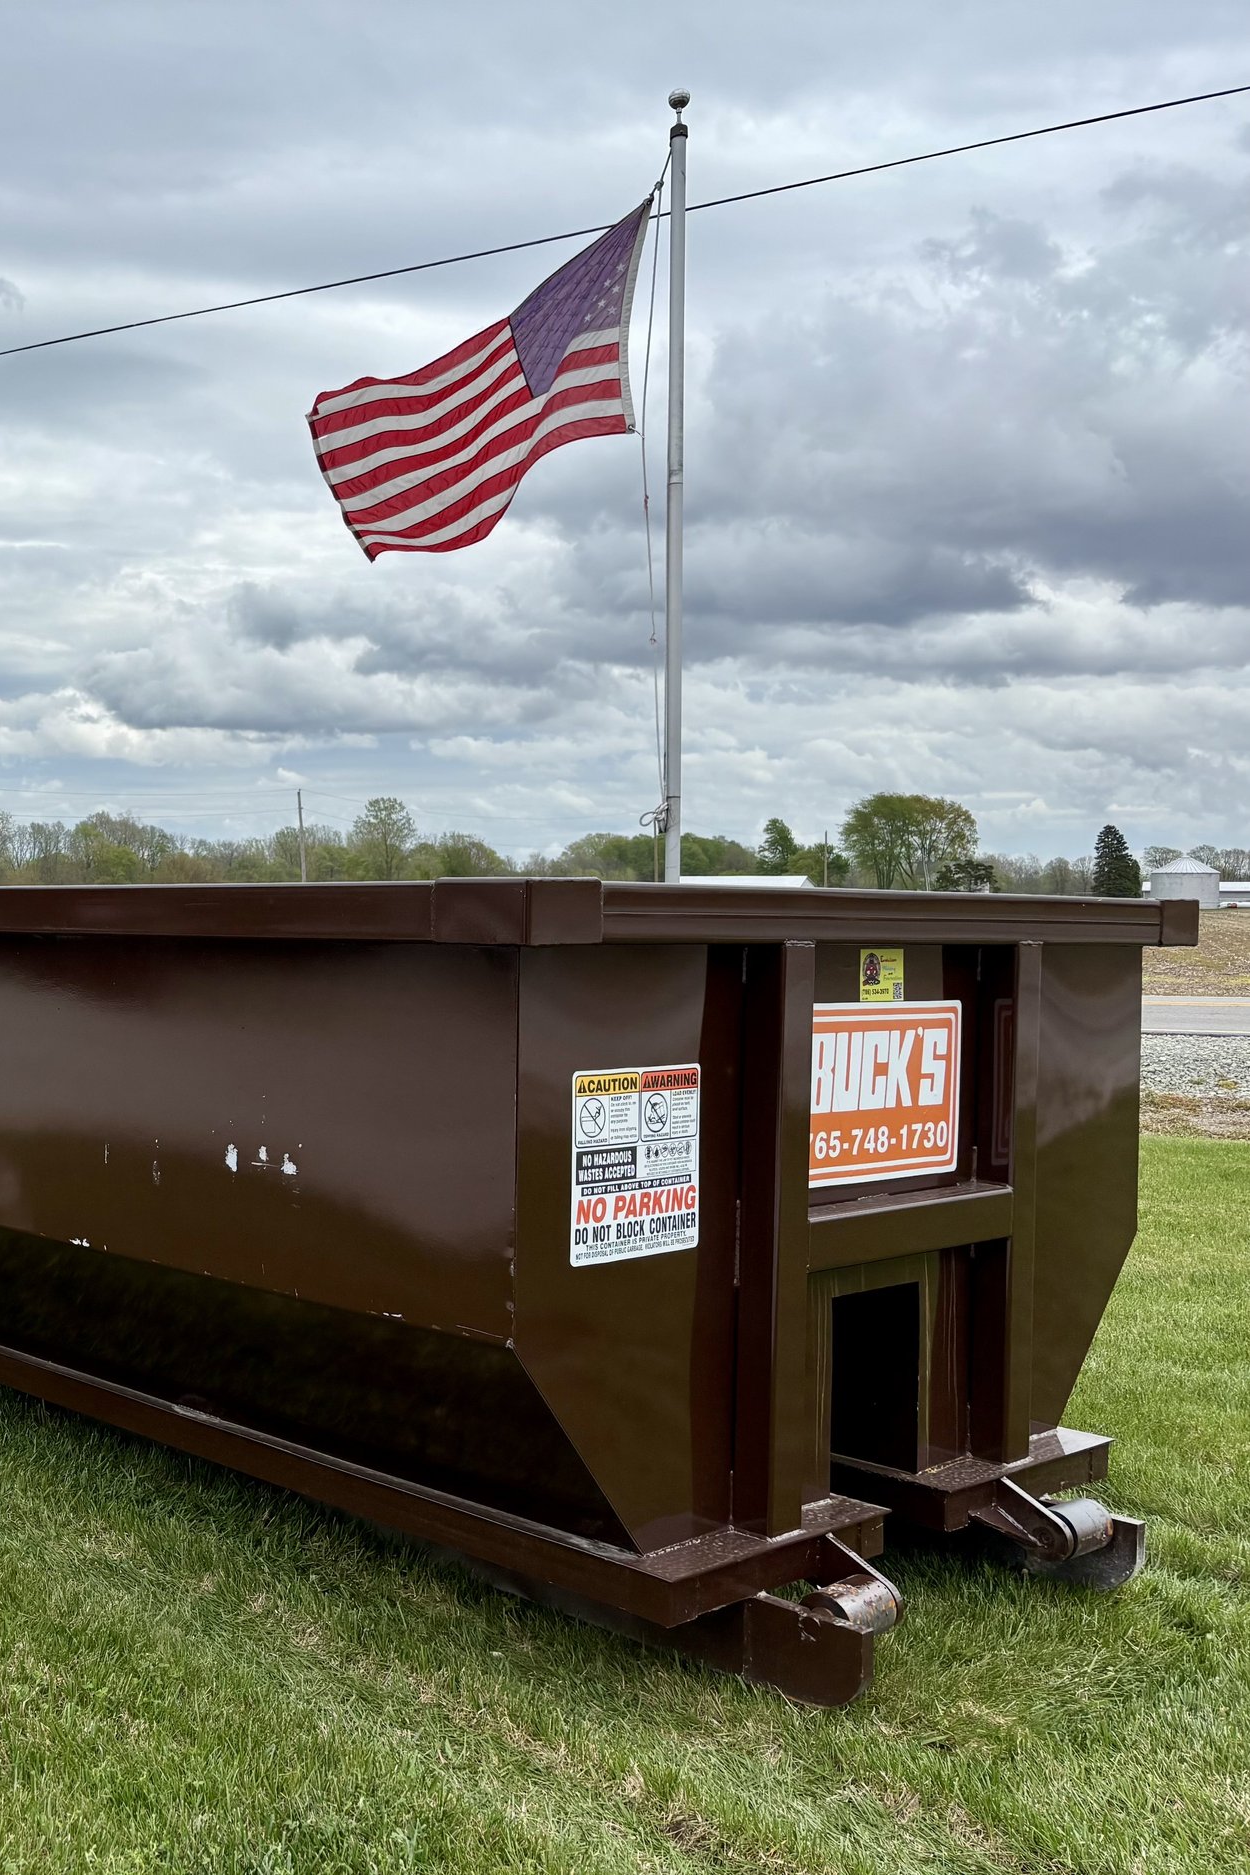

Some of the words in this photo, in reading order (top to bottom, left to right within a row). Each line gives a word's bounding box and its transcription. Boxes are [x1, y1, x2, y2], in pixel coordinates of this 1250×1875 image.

[810, 1026, 948, 1114] BUCK'S
[588, 1077, 638, 1094] CAUTION
[651, 1072, 697, 1088] WARNING
[582, 1154, 592, 1167] NO
[593, 1150, 632, 1166] HAZARDOUS
[578, 1168, 603, 1182] WASTES
[604, 1164, 635, 1179] ACCEPTED
[593, 1186, 605, 1194] NOT
[607, 1185, 619, 1193] FILL
[621, 1182, 639, 1191] ABOVE
[641, 1181, 651, 1189] TOP
[661, 1176, 690, 1186] CONTAINER
[576, 1197, 607, 1225] NO
[613, 1185, 697, 1220] PARKING
[575, 1227, 588, 1246] DO
[593, 1224, 612, 1243] NOT
[616, 1220, 645, 1240] BLOCK
[650, 1212, 696, 1235] CONTAINER
[586, 1244, 599, 1252] THIS
[600, 1240, 631, 1250] CONTAINER
[639, 1235, 660, 1244] PRIVATE
[591, 1249, 609, 1259] DISPOSAL
[614, 1246, 626, 1255] PUBLIC
[645, 1241, 662, 1250] VIOLATORS
